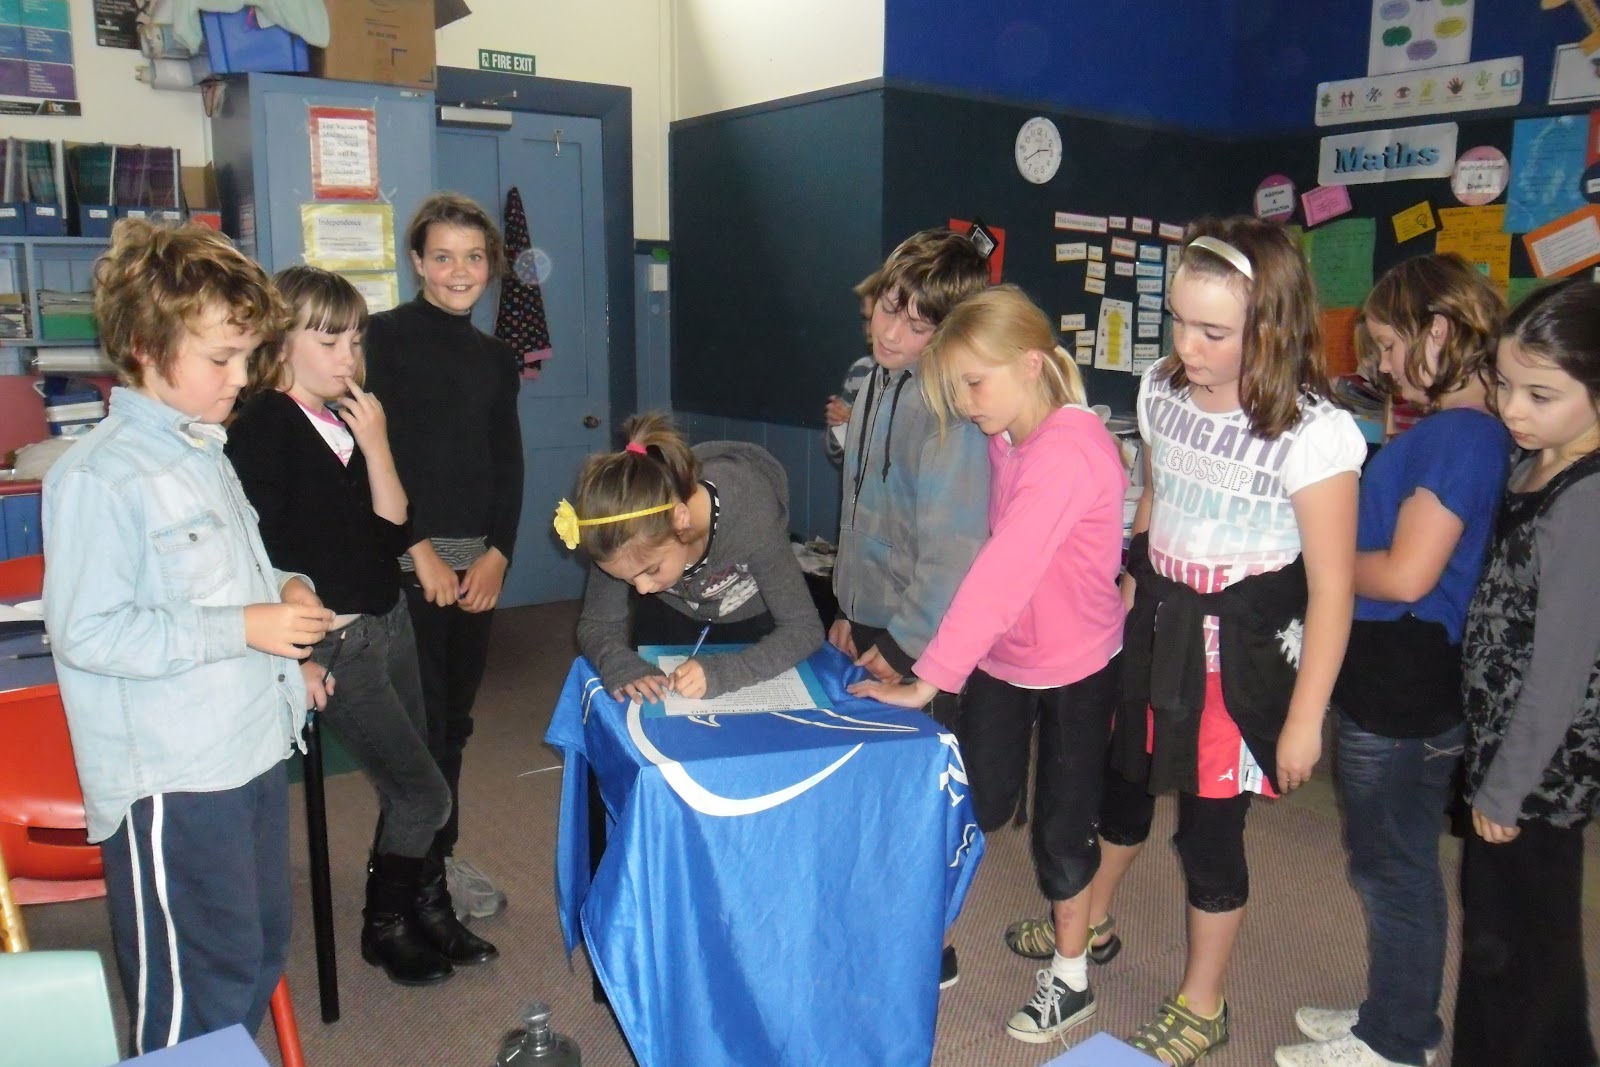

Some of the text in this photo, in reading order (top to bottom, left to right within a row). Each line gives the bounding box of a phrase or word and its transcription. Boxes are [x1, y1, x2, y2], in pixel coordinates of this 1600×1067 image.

[492, 53, 533, 72] FIRE EXIT
[1334, 142, 1439, 174] Maths
[318, 218, 362, 227] Independence
[1165, 445, 1254, 493] GOSSIP
